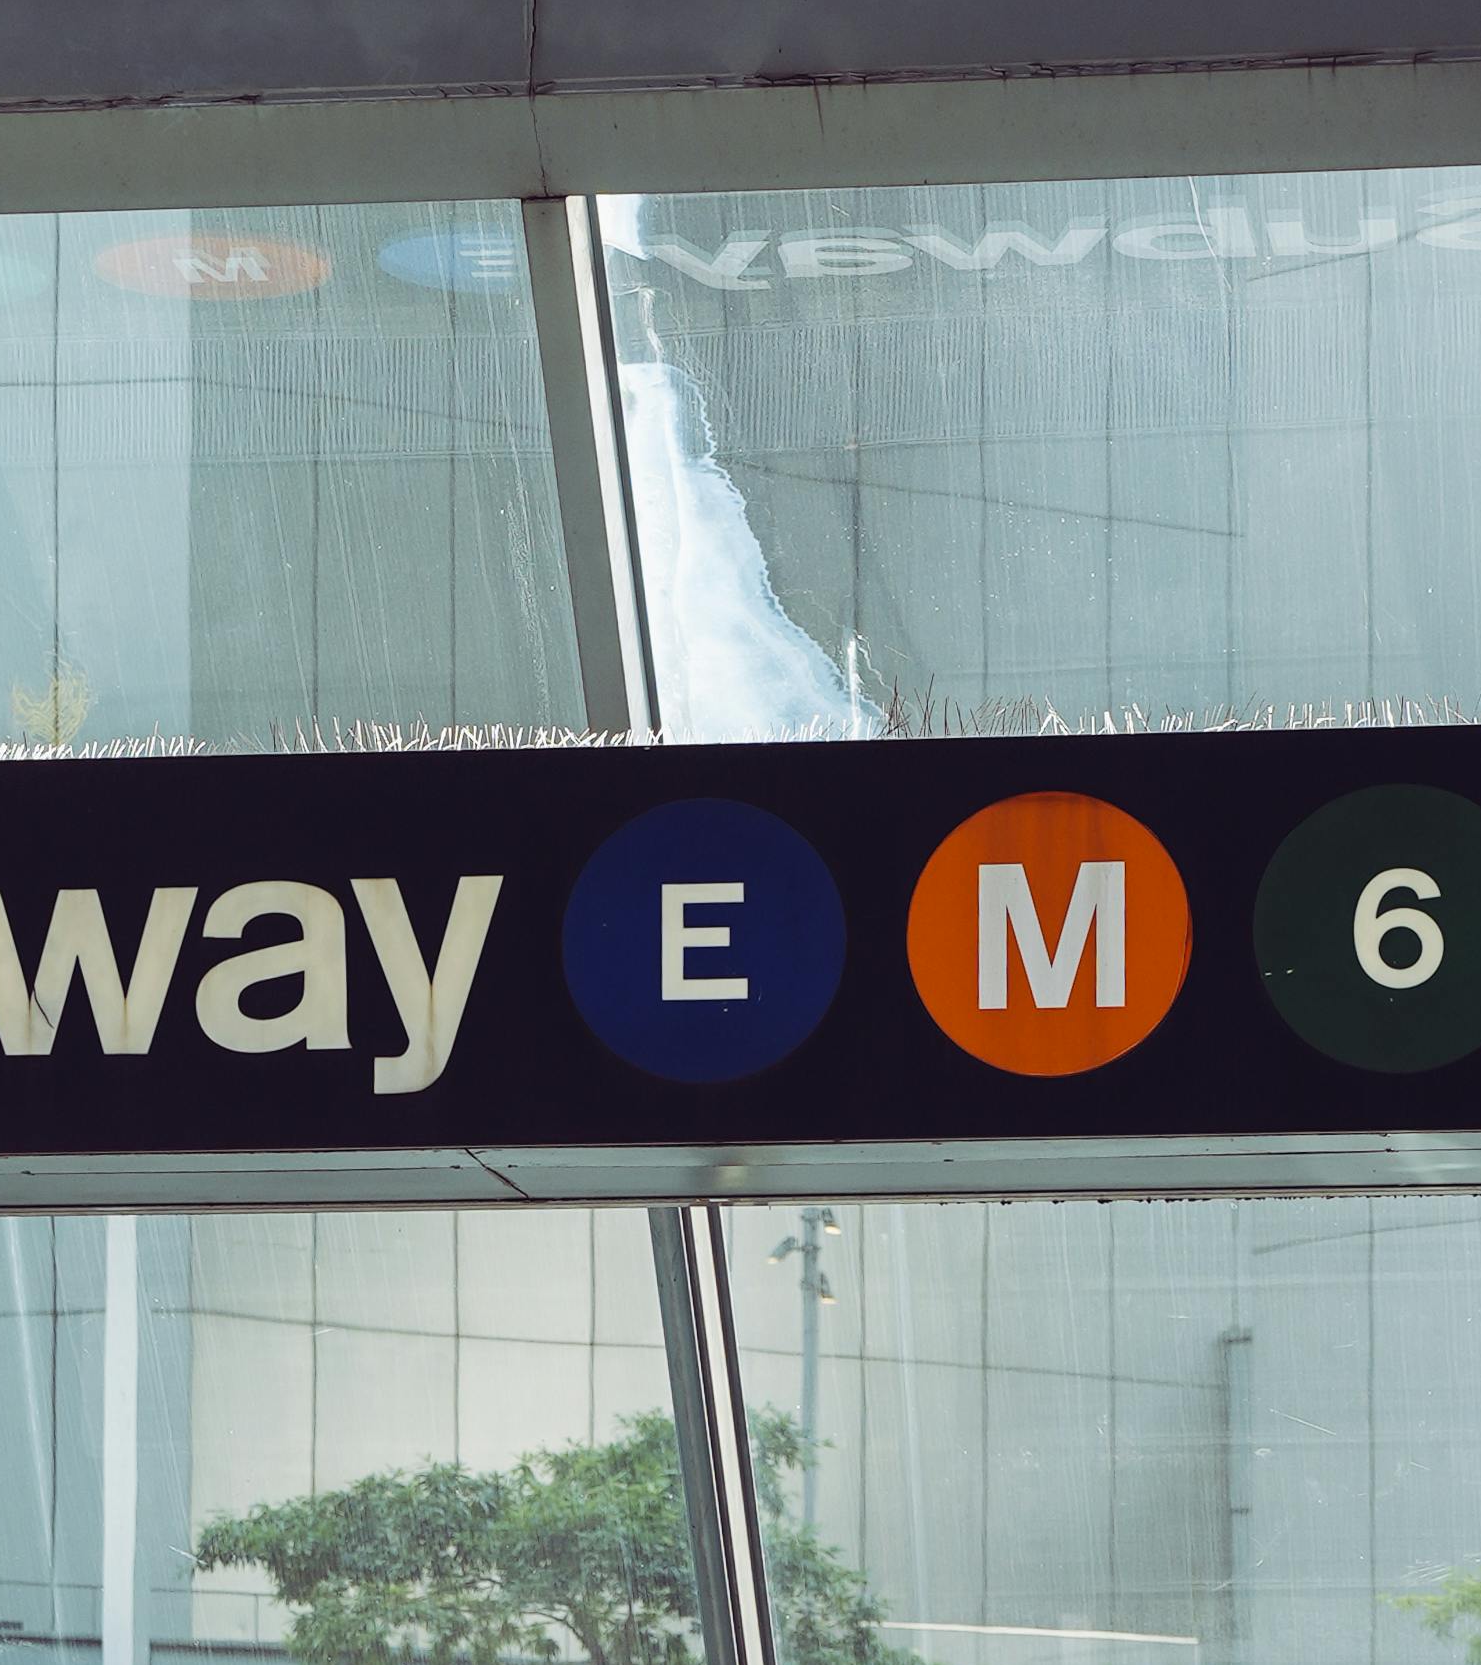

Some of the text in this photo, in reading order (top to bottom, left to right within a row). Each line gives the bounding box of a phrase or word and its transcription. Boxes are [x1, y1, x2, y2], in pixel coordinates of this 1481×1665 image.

[661, 882, 749, 1002] E
[976, 861, 1126, 1011] M
[1352, 868, 1444, 990] 6
